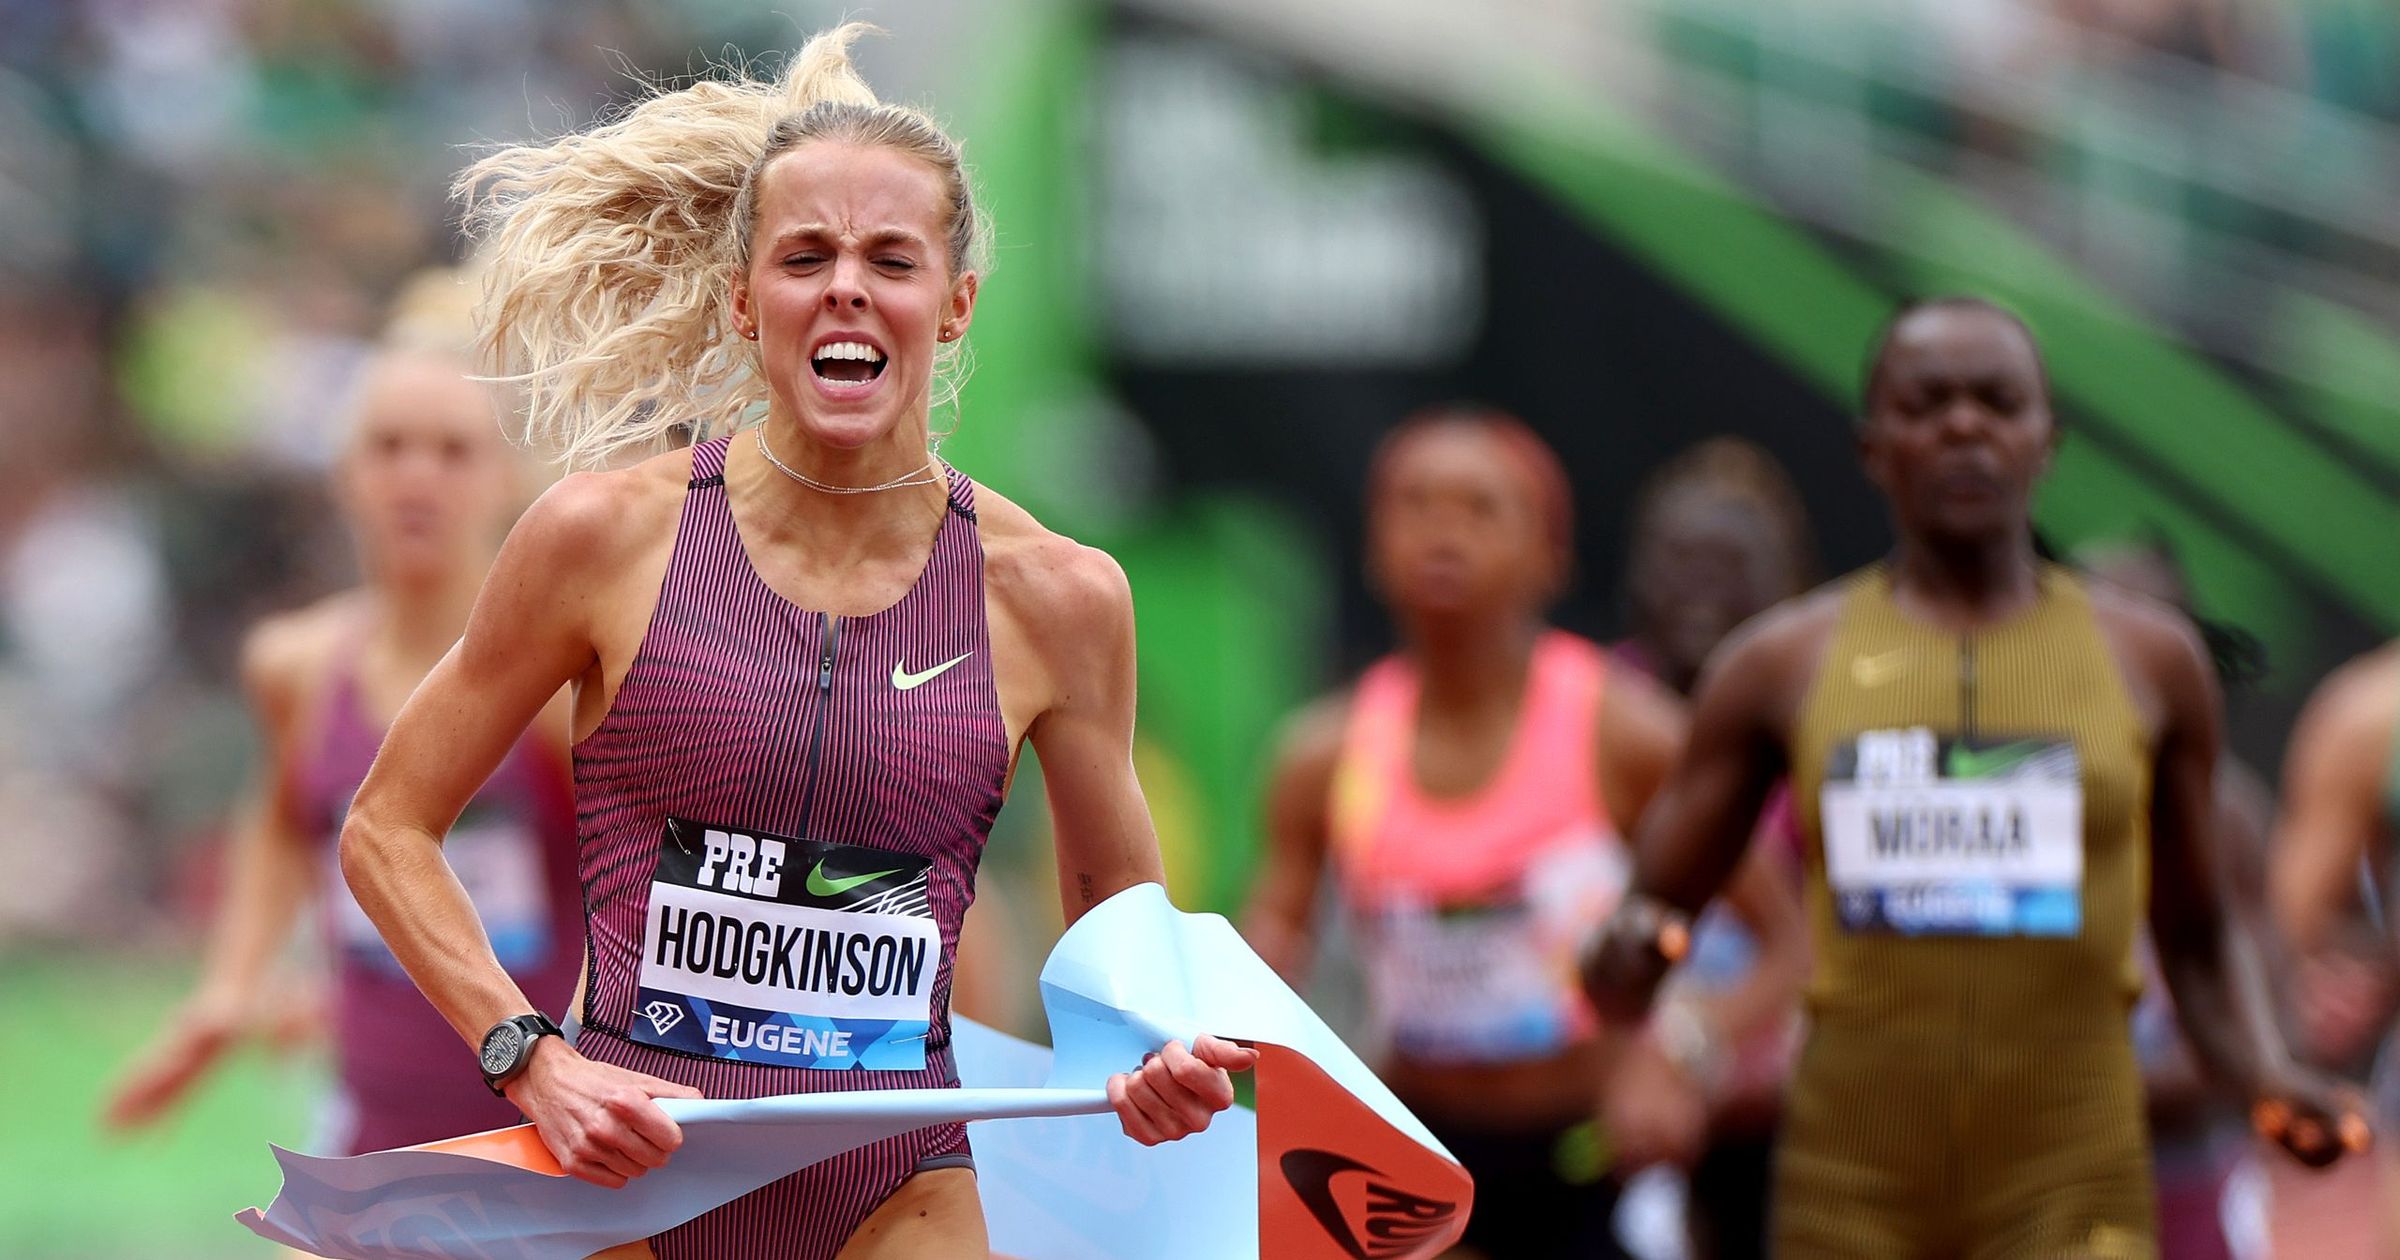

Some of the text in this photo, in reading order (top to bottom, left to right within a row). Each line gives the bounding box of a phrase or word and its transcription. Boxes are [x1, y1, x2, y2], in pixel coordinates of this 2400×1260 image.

[697, 829, 786, 897] PRE
[656, 905, 926, 996] HODGKINSON
[707, 1015, 852, 1057] EUGENE
